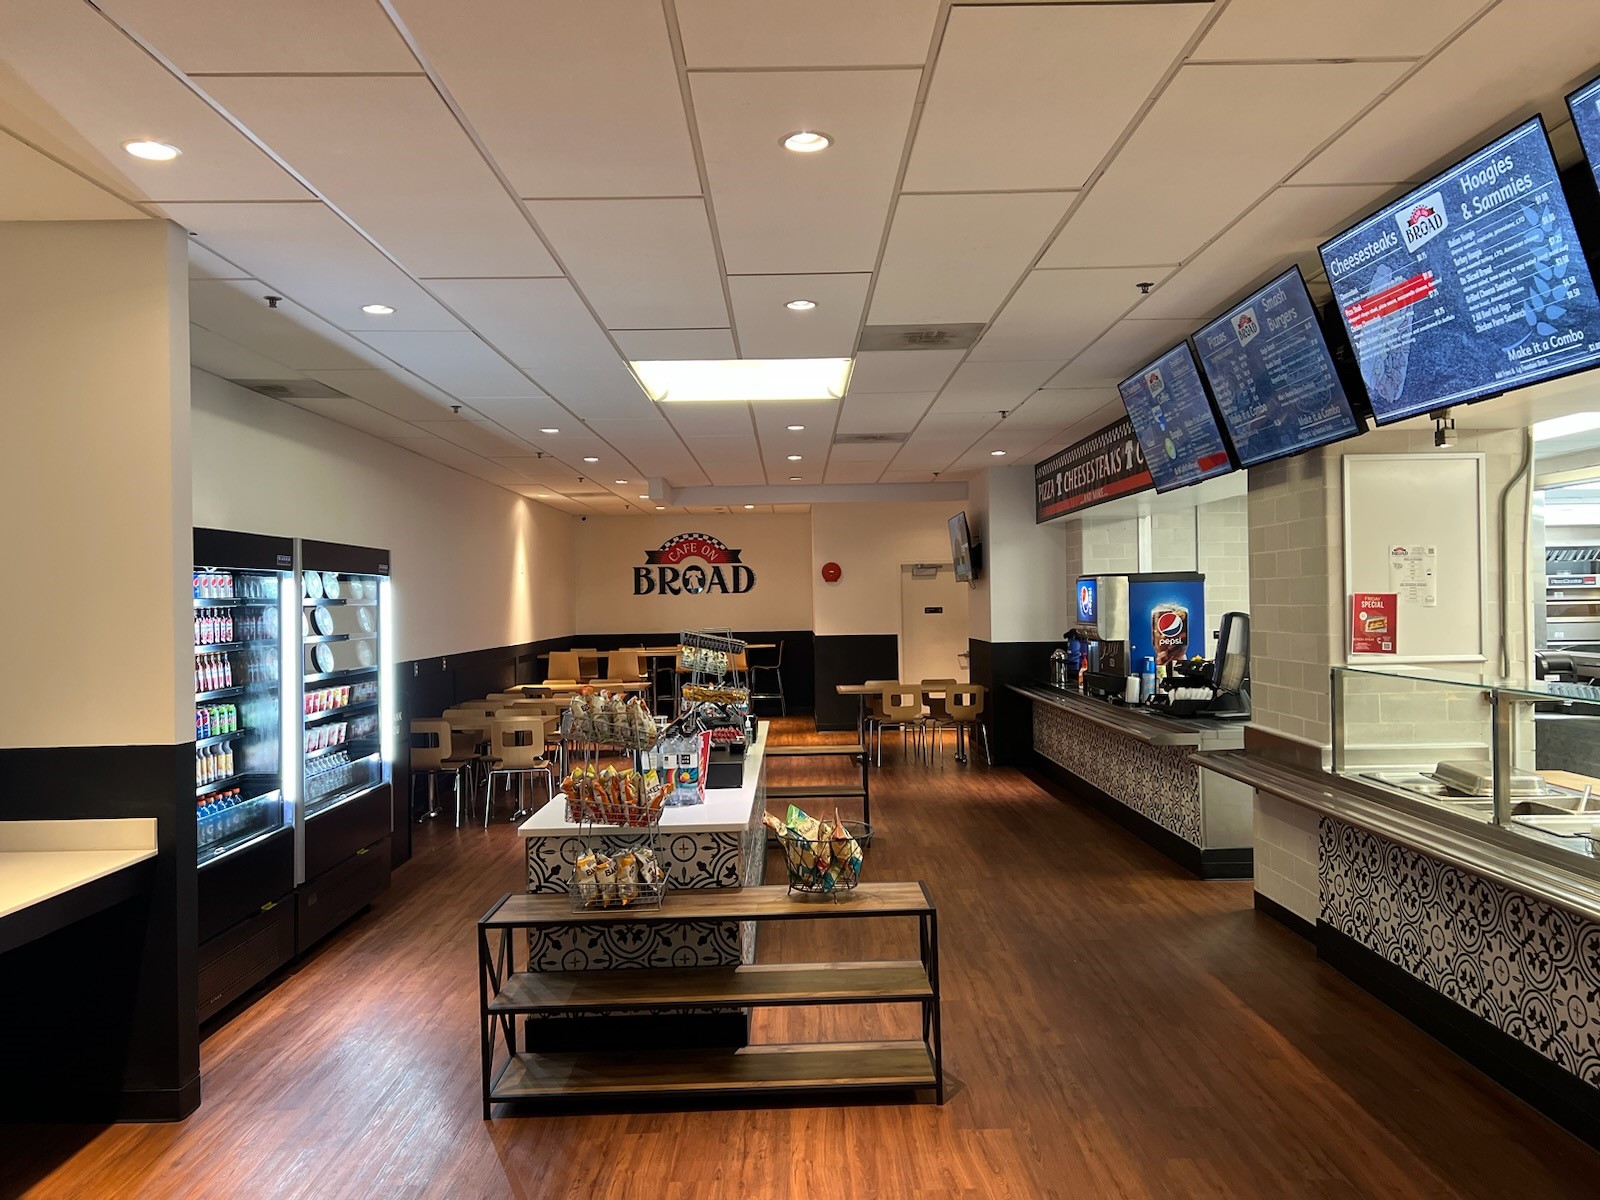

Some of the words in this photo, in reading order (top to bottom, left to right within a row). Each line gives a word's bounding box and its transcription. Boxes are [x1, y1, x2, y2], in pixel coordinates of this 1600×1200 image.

[1460, 156, 1512, 193] Hoagies
[1461, 205, 1472, 220] &
[1472, 174, 1532, 213] Sammies
[1405, 213, 1442, 243] BROAD
[1330, 231, 1397, 275] Cheesesteaks
[1453, 255, 1468, 266] Turkey
[1465, 270, 1479, 282] Sliced
[1478, 264, 1492, 276] Bread
[1261, 288, 1286, 311] Smash
[1465, 291, 1480, 303] Grilled
[1479, 287, 1495, 297] Cheese
[1494, 276, 1517, 291] Sandwich
[1266, 307, 1297, 331] Burgers
[1471, 314, 1476, 322] 2
[1481, 307, 1491, 318] Beef
[1498, 302, 1511, 311] Dogs
[1475, 322, 1492, 332] Chicken
[1503, 308, 1526, 322] Sandwich
[1207, 332, 1226, 348] Pizzas
[1237, 322, 1257, 340] BROAD
[1506, 345, 1532, 360] Make
[1531, 342, 1541, 353] it
[1542, 341, 1549, 350] a
[1549, 329, 1583, 347] Combo
[1228, 412, 1242, 424] Make
[1249, 402, 1267, 416] Combo
[1297, 414, 1312, 425] Make
[1311, 412, 1318, 421] it
[1320, 404, 1340, 417] Combo
[1038, 478, 1055, 503] PIZZA
[1064, 447, 1122, 492] CHEESESTEAKS
[667, 542, 697, 562] CAFE
[700, 544, 719, 561] ON
[632, 564, 756, 596] BROAD
[1361, 600, 1384, 609] SPECIAL
[1159, 638, 1183, 646] pepsi
